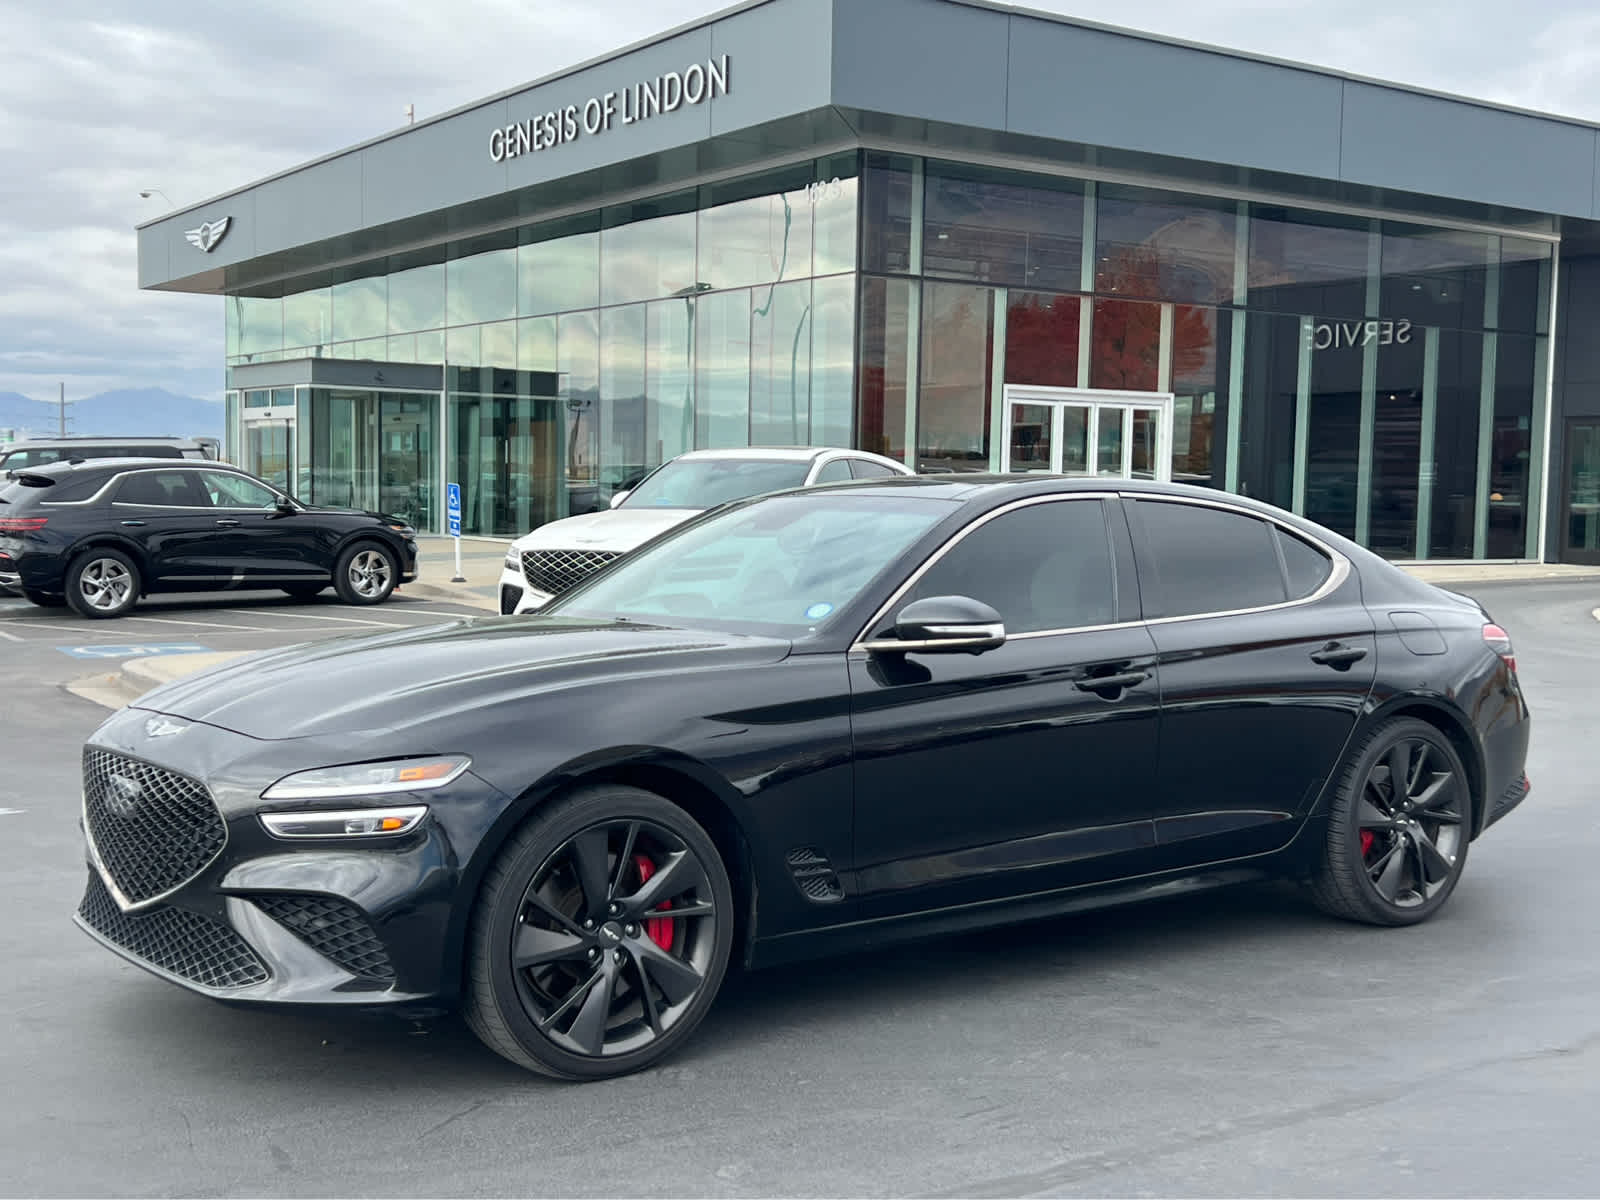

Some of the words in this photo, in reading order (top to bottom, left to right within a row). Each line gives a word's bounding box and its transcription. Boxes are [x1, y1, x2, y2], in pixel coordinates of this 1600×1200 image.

[489, 105, 578, 162] GENESIS
[583, 91, 616, 134] OF
[622, 54, 729, 124] LINDON
